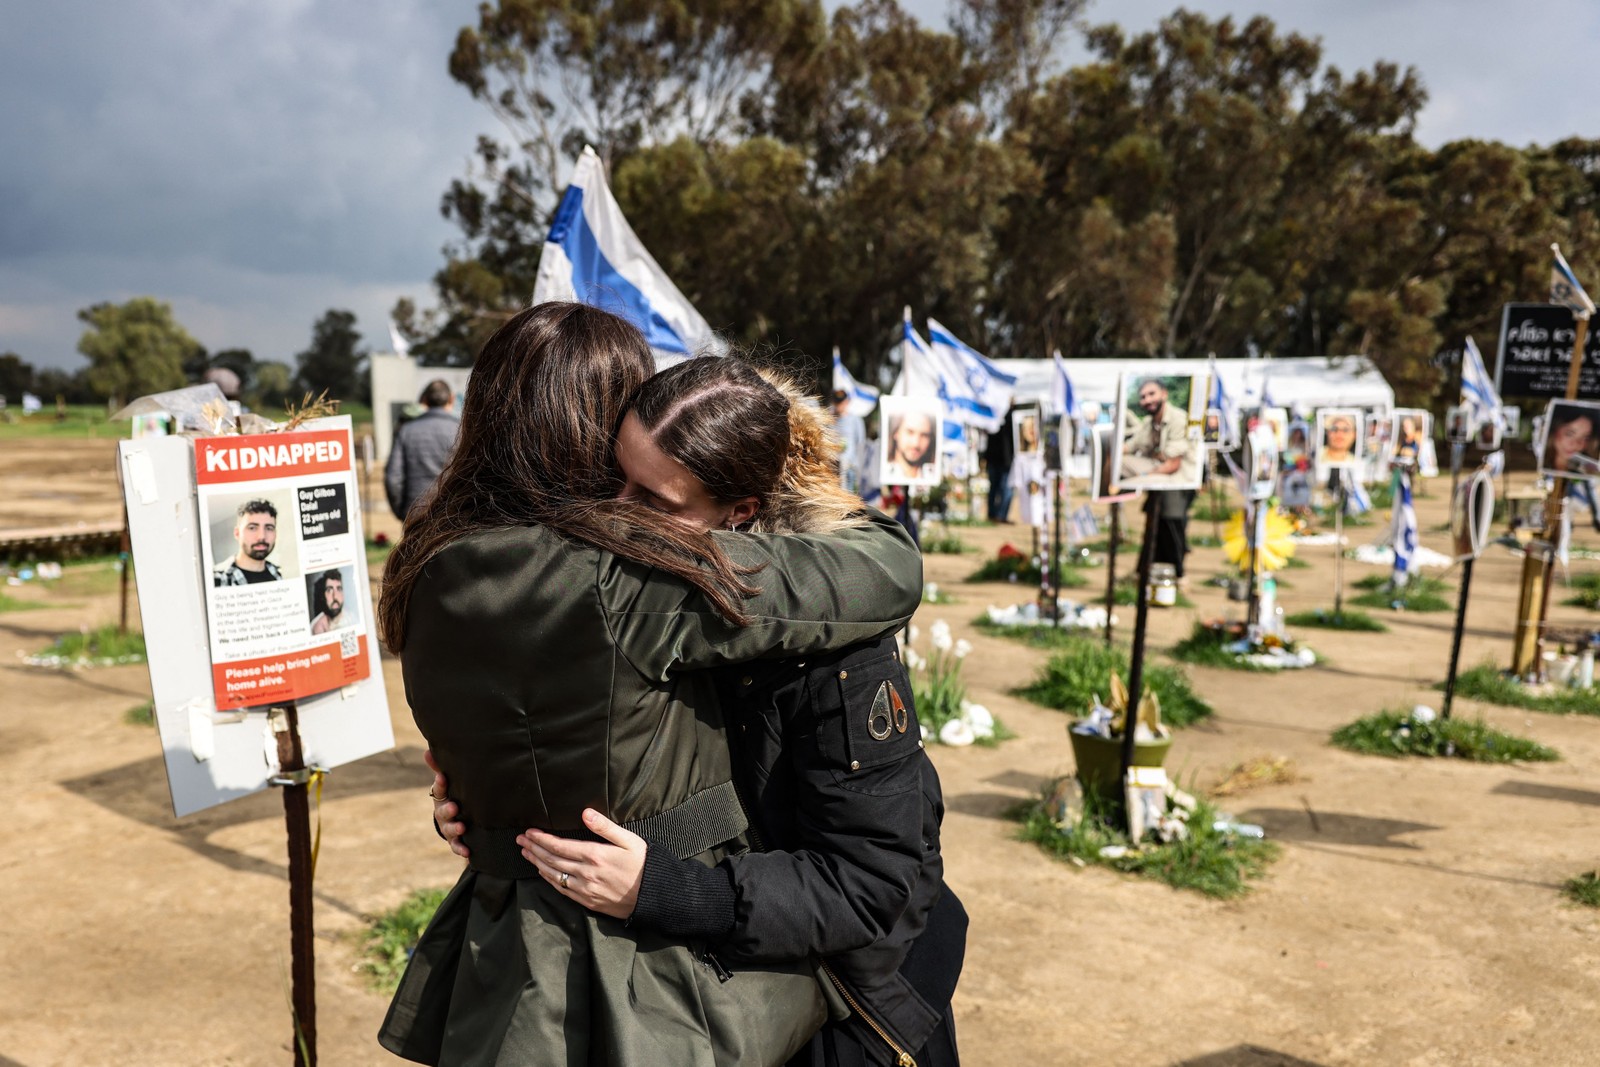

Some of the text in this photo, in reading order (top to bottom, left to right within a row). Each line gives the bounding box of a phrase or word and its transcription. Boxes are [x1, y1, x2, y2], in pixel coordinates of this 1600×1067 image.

[205, 440, 343, 472] KIDNAPPED
[299, 487, 336, 501] Guy Gilboa
[302, 509, 341, 524] 22 years old
[303, 523, 324, 536] Israeli
[216, 609, 256, 618] Underground
[232, 635, 248, 643] need
[225, 653, 331, 679] Please help bring them
[226, 675, 286, 692] home alive.
